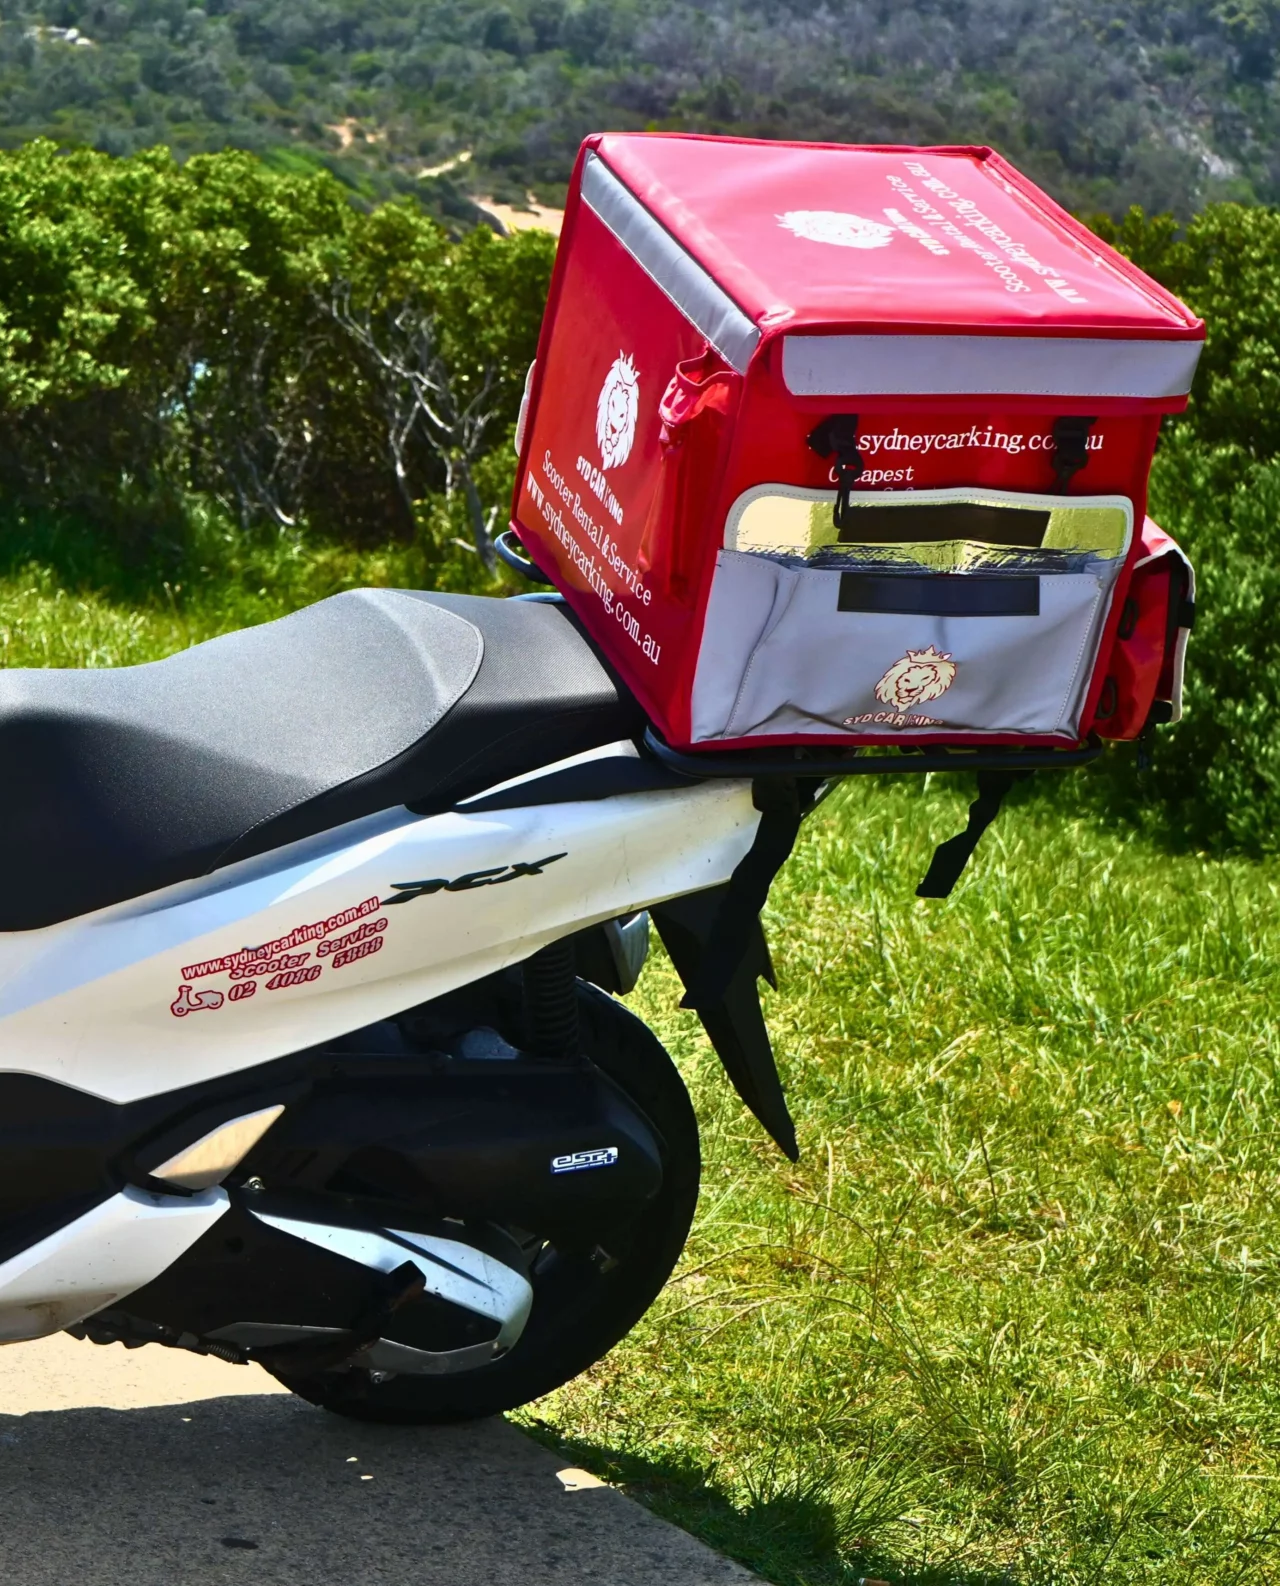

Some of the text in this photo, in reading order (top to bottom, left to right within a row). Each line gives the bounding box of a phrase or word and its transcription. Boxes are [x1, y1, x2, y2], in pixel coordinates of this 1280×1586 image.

[973, 246, 1031, 293] Scooter
[576, 455, 591, 482] SYD
[589, 467, 606, 502] CAR
[828, 465, 915, 485] Capest
[542, 449, 574, 508] Scooter
[572, 492, 602, 546] Rental
[608, 542, 652, 606] Service
[843, 713, 873, 725] SYD
[874, 712, 906, 726] CAR
[182, 896, 380, 980] www.sydneycarking.com.au
[229, 917, 388, 980] Scooter Service
[228, 936, 383, 1001] 02 4086 5888
